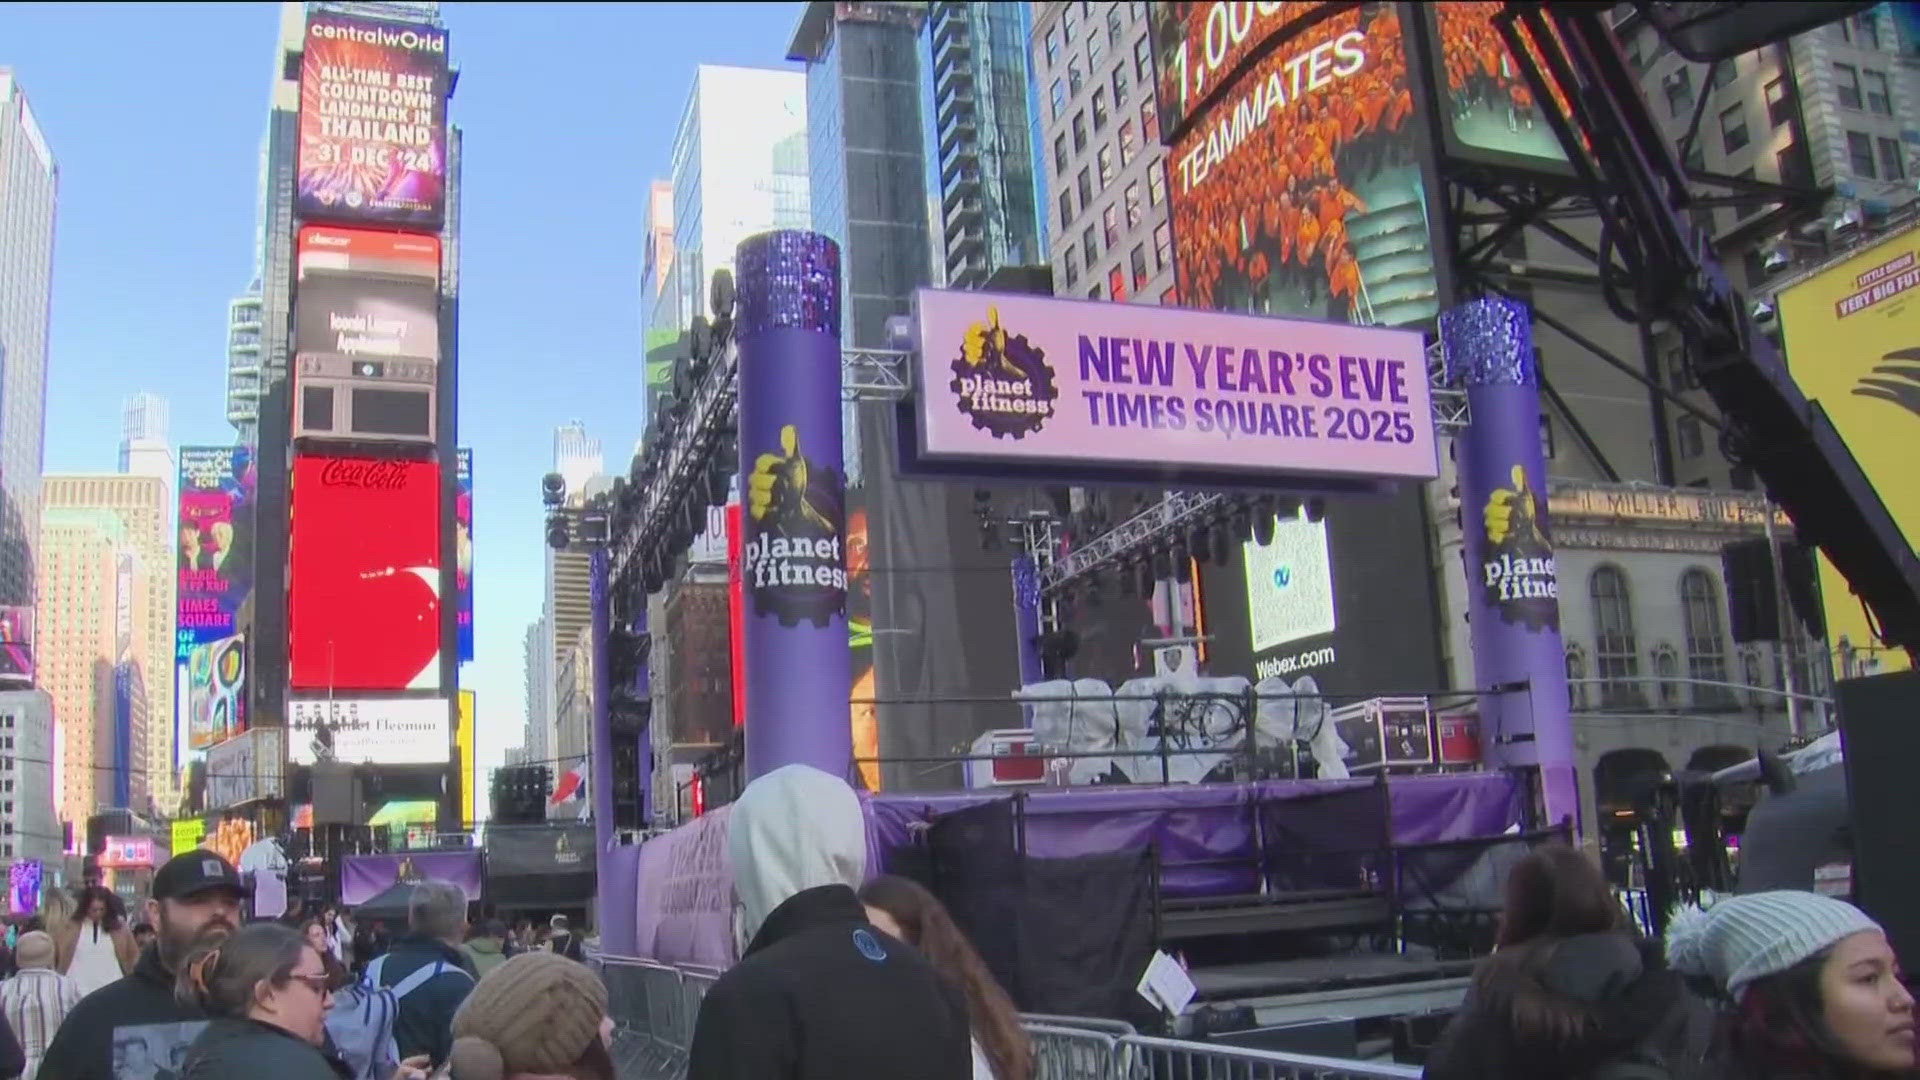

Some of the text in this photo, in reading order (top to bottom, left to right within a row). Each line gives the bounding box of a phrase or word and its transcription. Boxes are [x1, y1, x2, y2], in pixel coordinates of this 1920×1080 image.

[1174, 1, 1282, 119] 1,00
[321, 65, 433, 92] ALL-TIME BEST
[320, 82, 432, 109] COUNTDOWN
[320, 100, 432, 125] LANDMARK IN
[1178, 31, 1367, 196] TEAMMATES
[320, 117, 431, 146] THAILAND
[319, 144, 341, 163] 31
[351, 147, 389, 167] DEC
[1840, 290, 1871, 316] VERY
[1872, 280, 1895, 302] BIG
[1897, 269, 1920, 292] FUT
[1078, 334, 1409, 404] NEW YEAR'S EVE
[960, 373, 1033, 398] planet
[971, 393, 1050, 414] fitness
[1081, 390, 1415, 444] TIMES SQUARE 2025
[1608, 495, 1680, 517] MILLER
[745, 532, 840, 570] planet
[1484, 553, 1555, 587] plane
[1499, 576, 1557, 600] fitne
[178, 613, 230, 627] SQUARE
[1256, 646, 1335, 680] Webex.com
